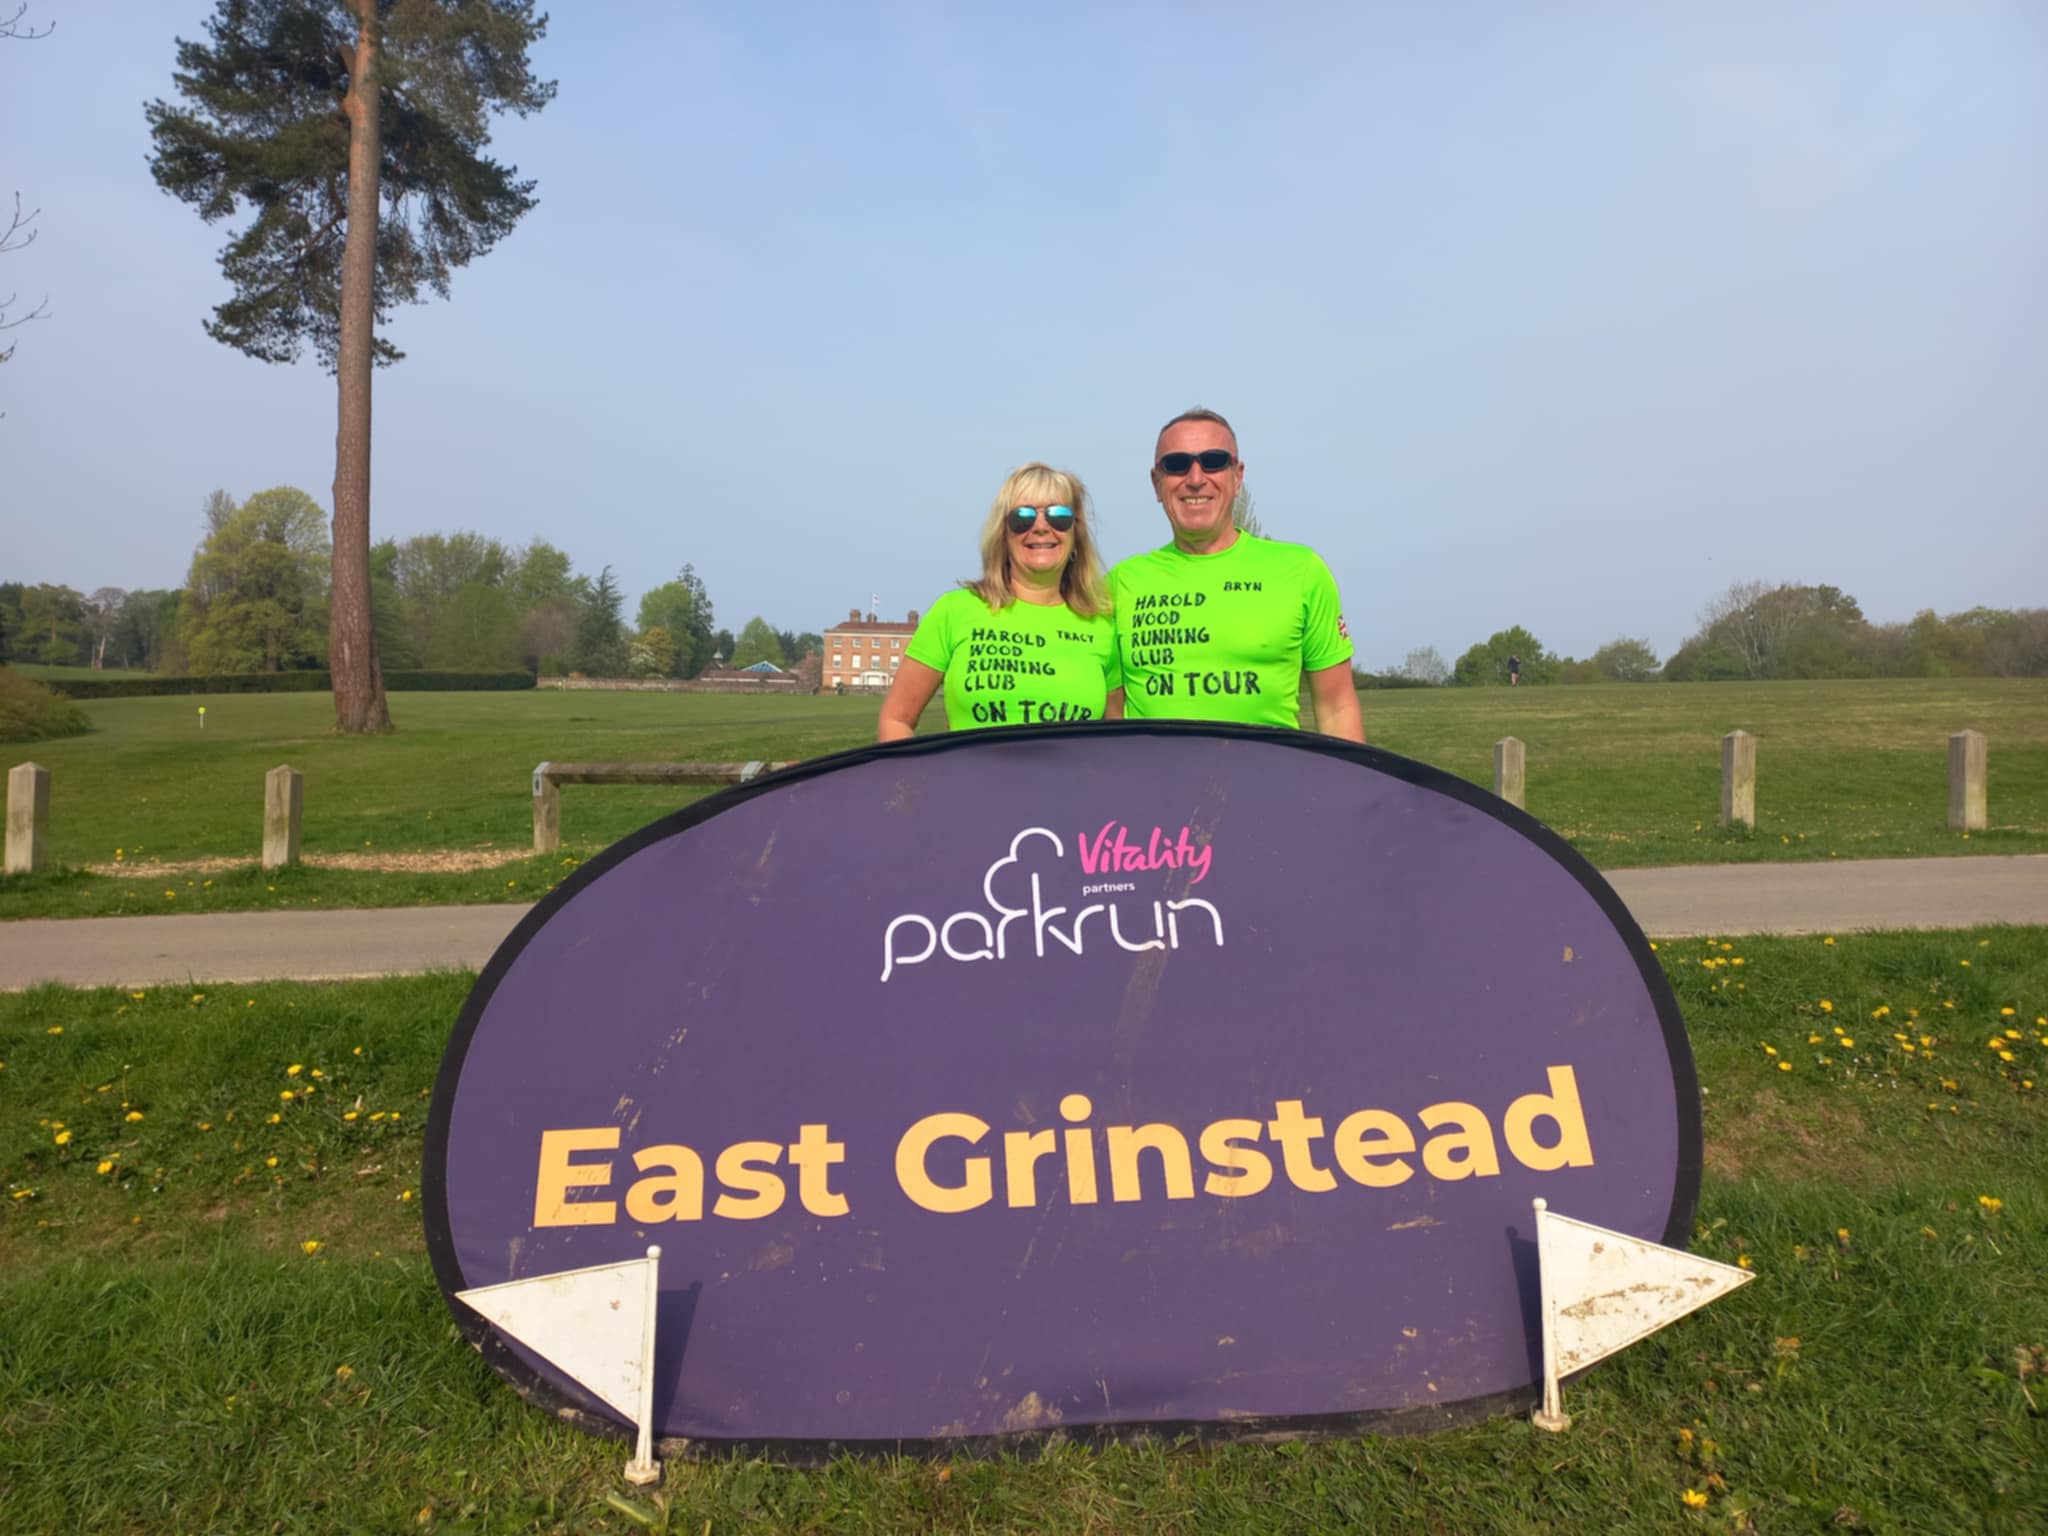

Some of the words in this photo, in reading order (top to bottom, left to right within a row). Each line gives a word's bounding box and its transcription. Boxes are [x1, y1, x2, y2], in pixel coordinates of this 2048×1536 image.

[1224, 580, 1263, 592] BRYN
[1135, 592, 1206, 610] HAROLD
[1132, 611, 1180, 628] WOOD
[971, 628, 1046, 647] HAROLD
[1057, 629, 1094, 643] TRACY
[1131, 628, 1210, 646] RUNNING
[970, 643, 1023, 657] WOOD
[1131, 649, 1175, 667] CLUB
[967, 659, 1056, 676] RUNNING
[965, 674, 1016, 691] CLUB
[1146, 673, 1175, 695] ON
[1184, 671, 1261, 695] TOUR
[972, 701, 1007, 723] ON
[1021, 700, 1093, 723] TOUR
[1078, 820, 1212, 885] Vitality
[1083, 880, 1135, 896] partners
[880, 873, 1224, 983] parkrun
[533, 1124, 850, 1228] East
[894, 1065, 1594, 1214] Grinstead
